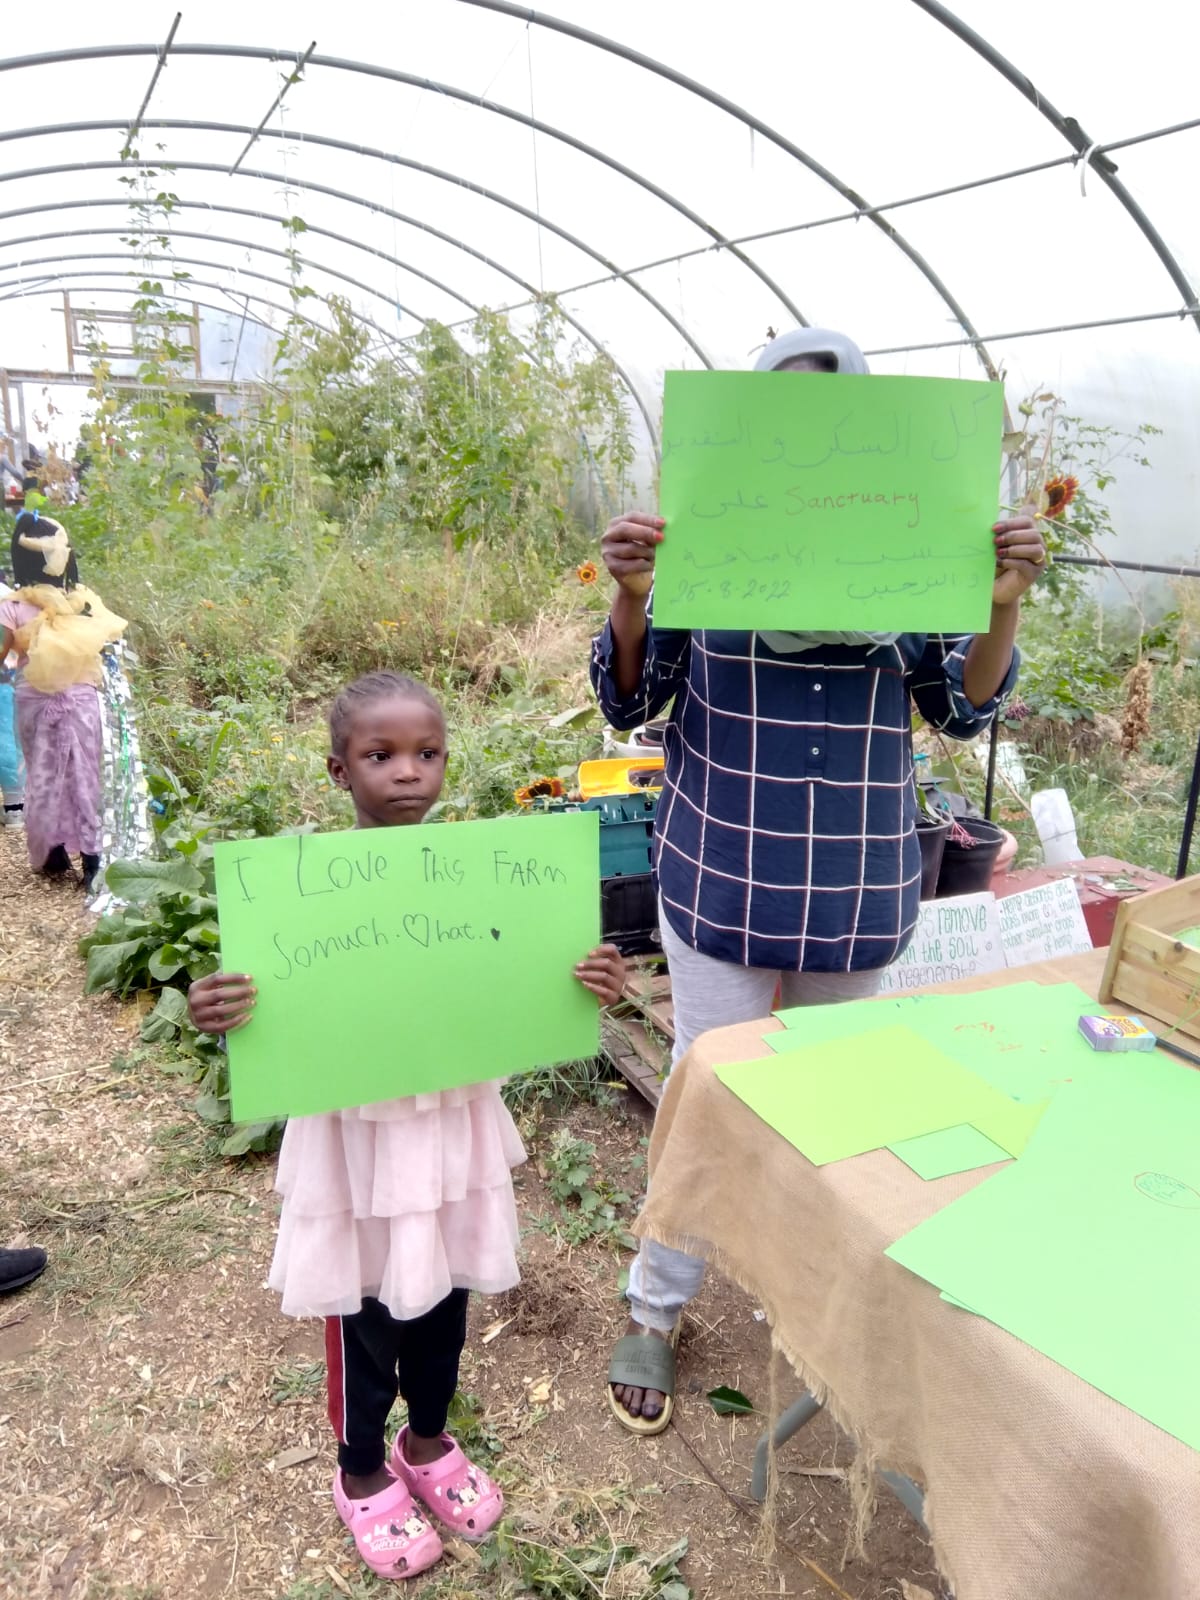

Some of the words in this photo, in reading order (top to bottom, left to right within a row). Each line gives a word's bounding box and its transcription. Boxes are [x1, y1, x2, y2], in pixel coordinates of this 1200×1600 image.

[931, 391, 992, 462] كل
[783, 485, 921, 529] Sanctuary
[232, 856, 257, 904] I
[936, 903, 989, 937] remove
[921, 937, 944, 964] the
